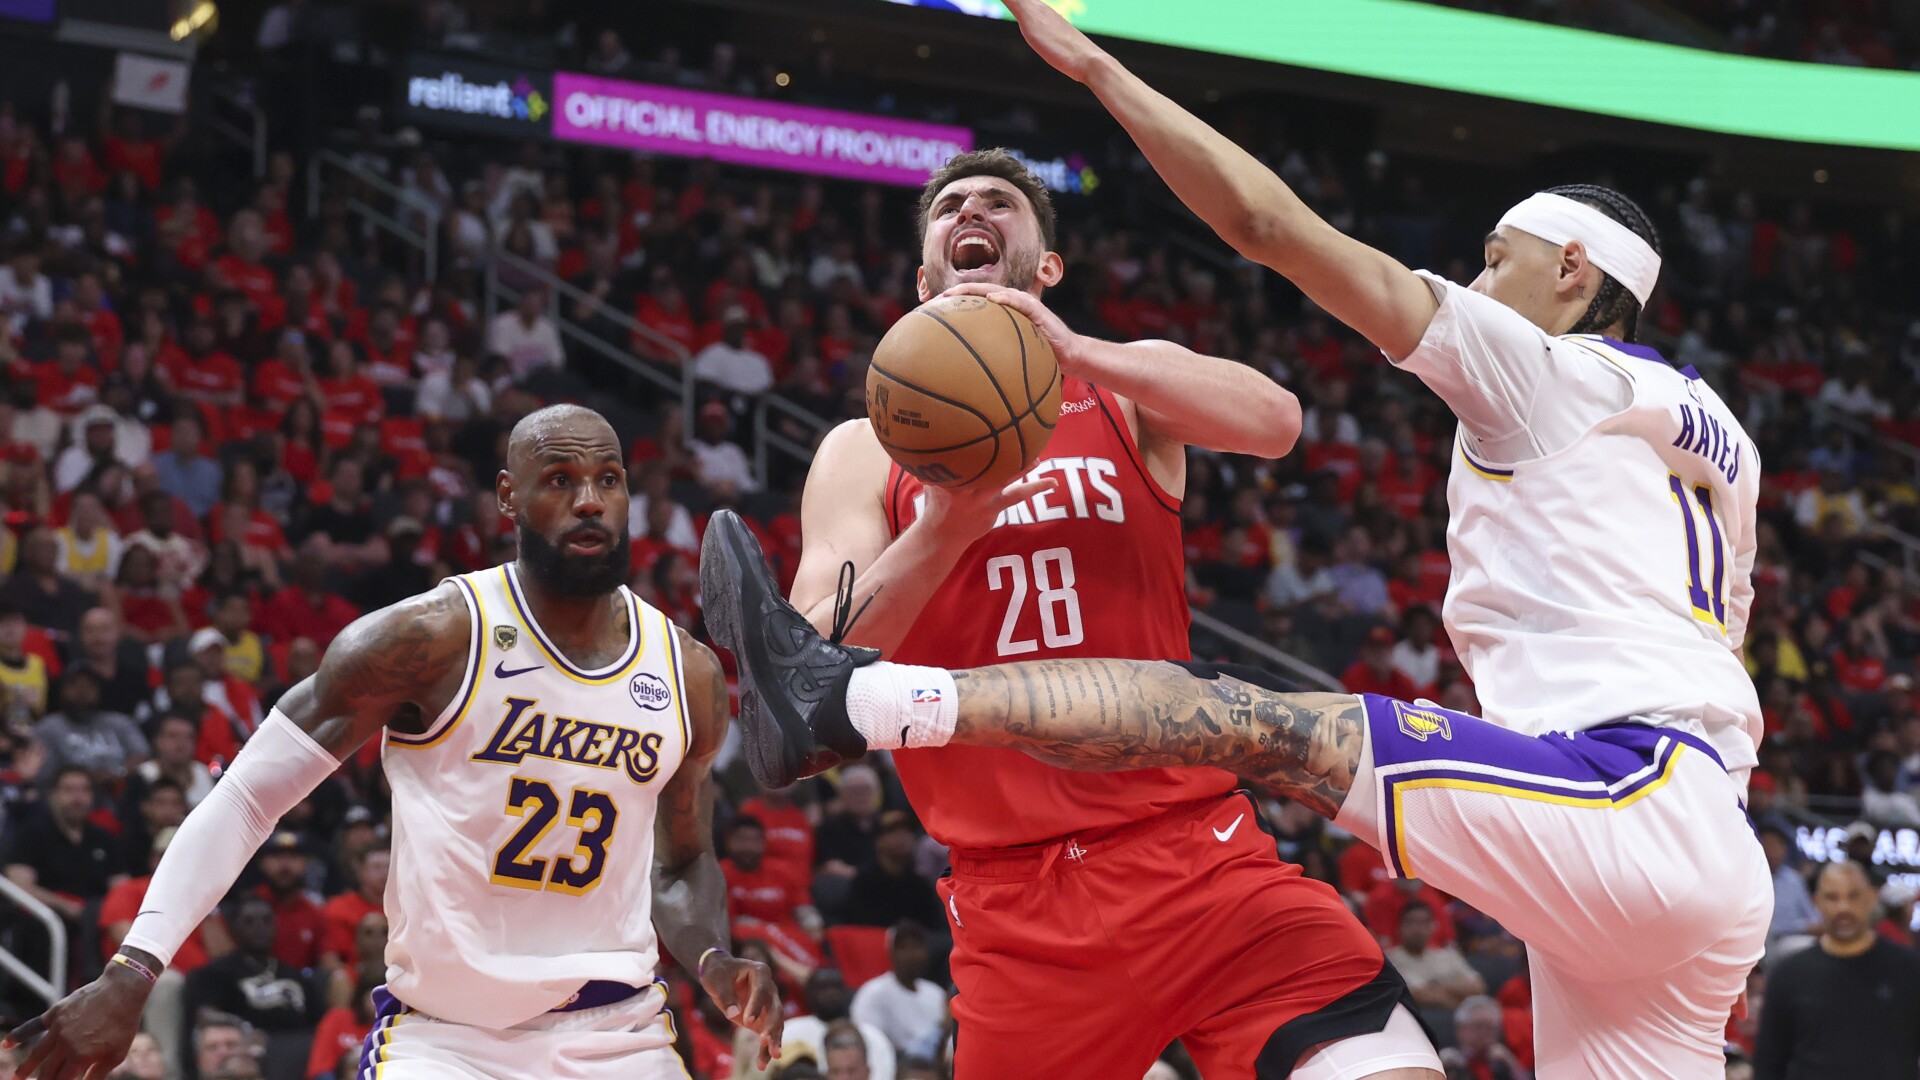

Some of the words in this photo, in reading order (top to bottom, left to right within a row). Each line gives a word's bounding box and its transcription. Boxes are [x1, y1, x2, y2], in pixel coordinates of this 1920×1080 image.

[408, 72, 512, 118] reliant
[564, 91, 703, 142] OFFICIAL
[705, 109, 819, 157] ENERGY
[1672, 404, 1740, 485] HAYES
[1667, 469, 1727, 638] 11
[986, 547, 1084, 656] 28
[633, 681, 669, 702] bibigo
[468, 695, 664, 786] LAKERS
[490, 775, 620, 897] 23
